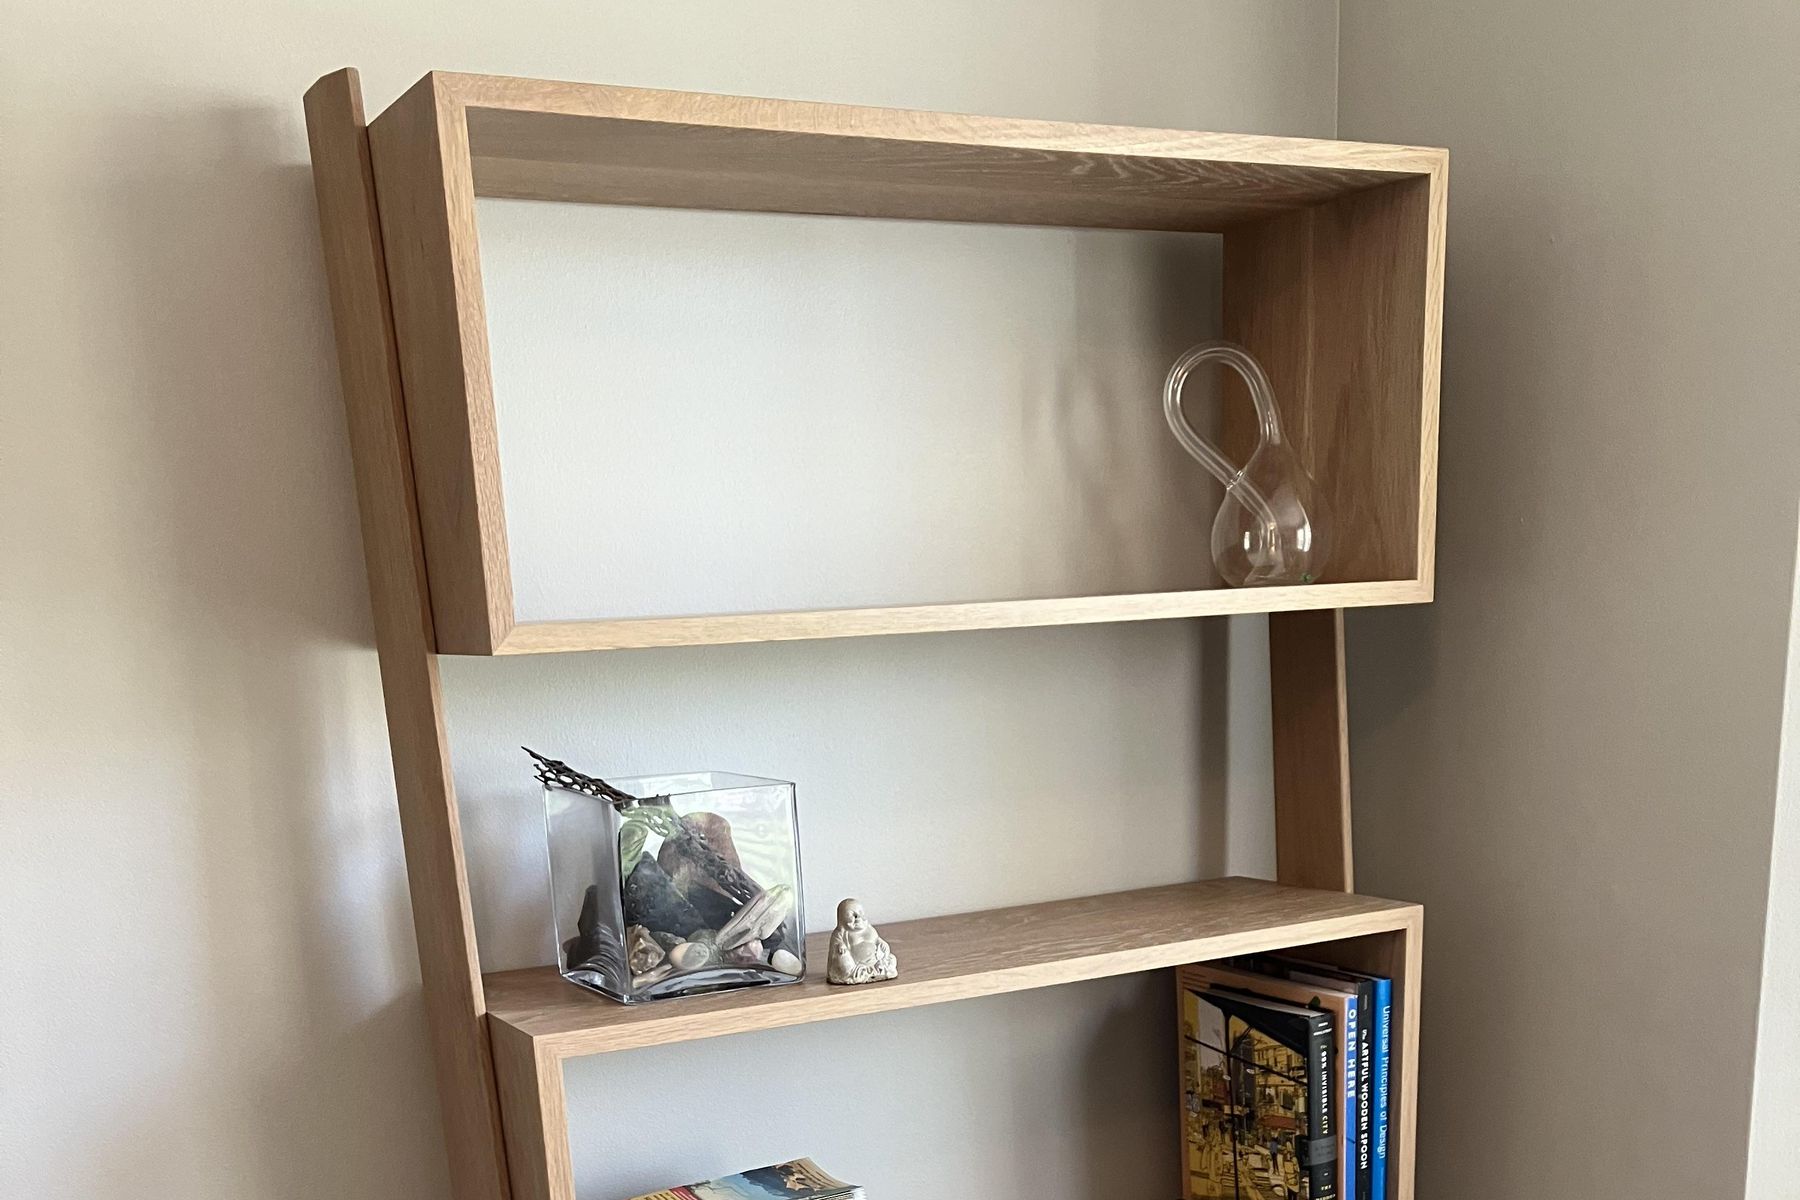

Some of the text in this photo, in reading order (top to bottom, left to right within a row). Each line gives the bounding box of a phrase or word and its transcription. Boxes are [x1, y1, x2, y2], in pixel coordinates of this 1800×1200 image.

[1382, 1005, 1391, 1054] Universal
[1347, 1008, 1357, 1098] OPEN HERE
[1361, 1042, 1369, 1081] ARTFUL
[1379, 1056, 1389, 1109] Principles
[1380, 1111, 1388, 1121] of
[1360, 1132, 1368, 1170] SPOON
[1377, 1124, 1388, 1159] Design
